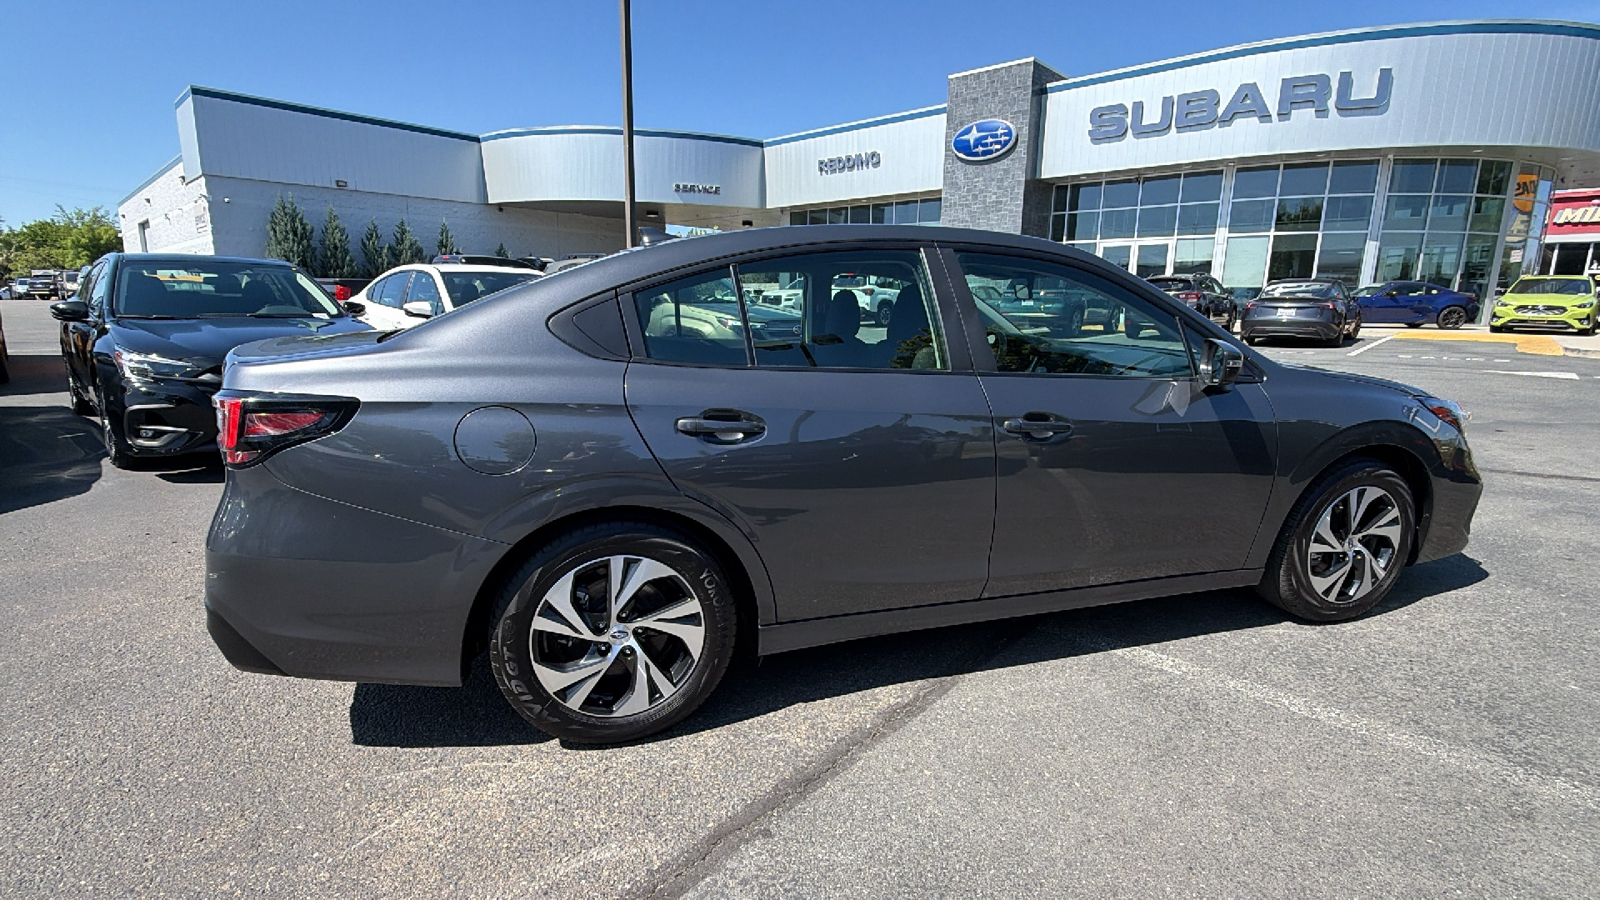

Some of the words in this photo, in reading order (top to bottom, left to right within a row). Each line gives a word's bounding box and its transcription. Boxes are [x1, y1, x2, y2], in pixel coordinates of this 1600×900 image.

[1088, 68, 1393, 143] SUBARU
[818, 151, 881, 175] REDDING
[674, 183, 721, 195] SERVICE
